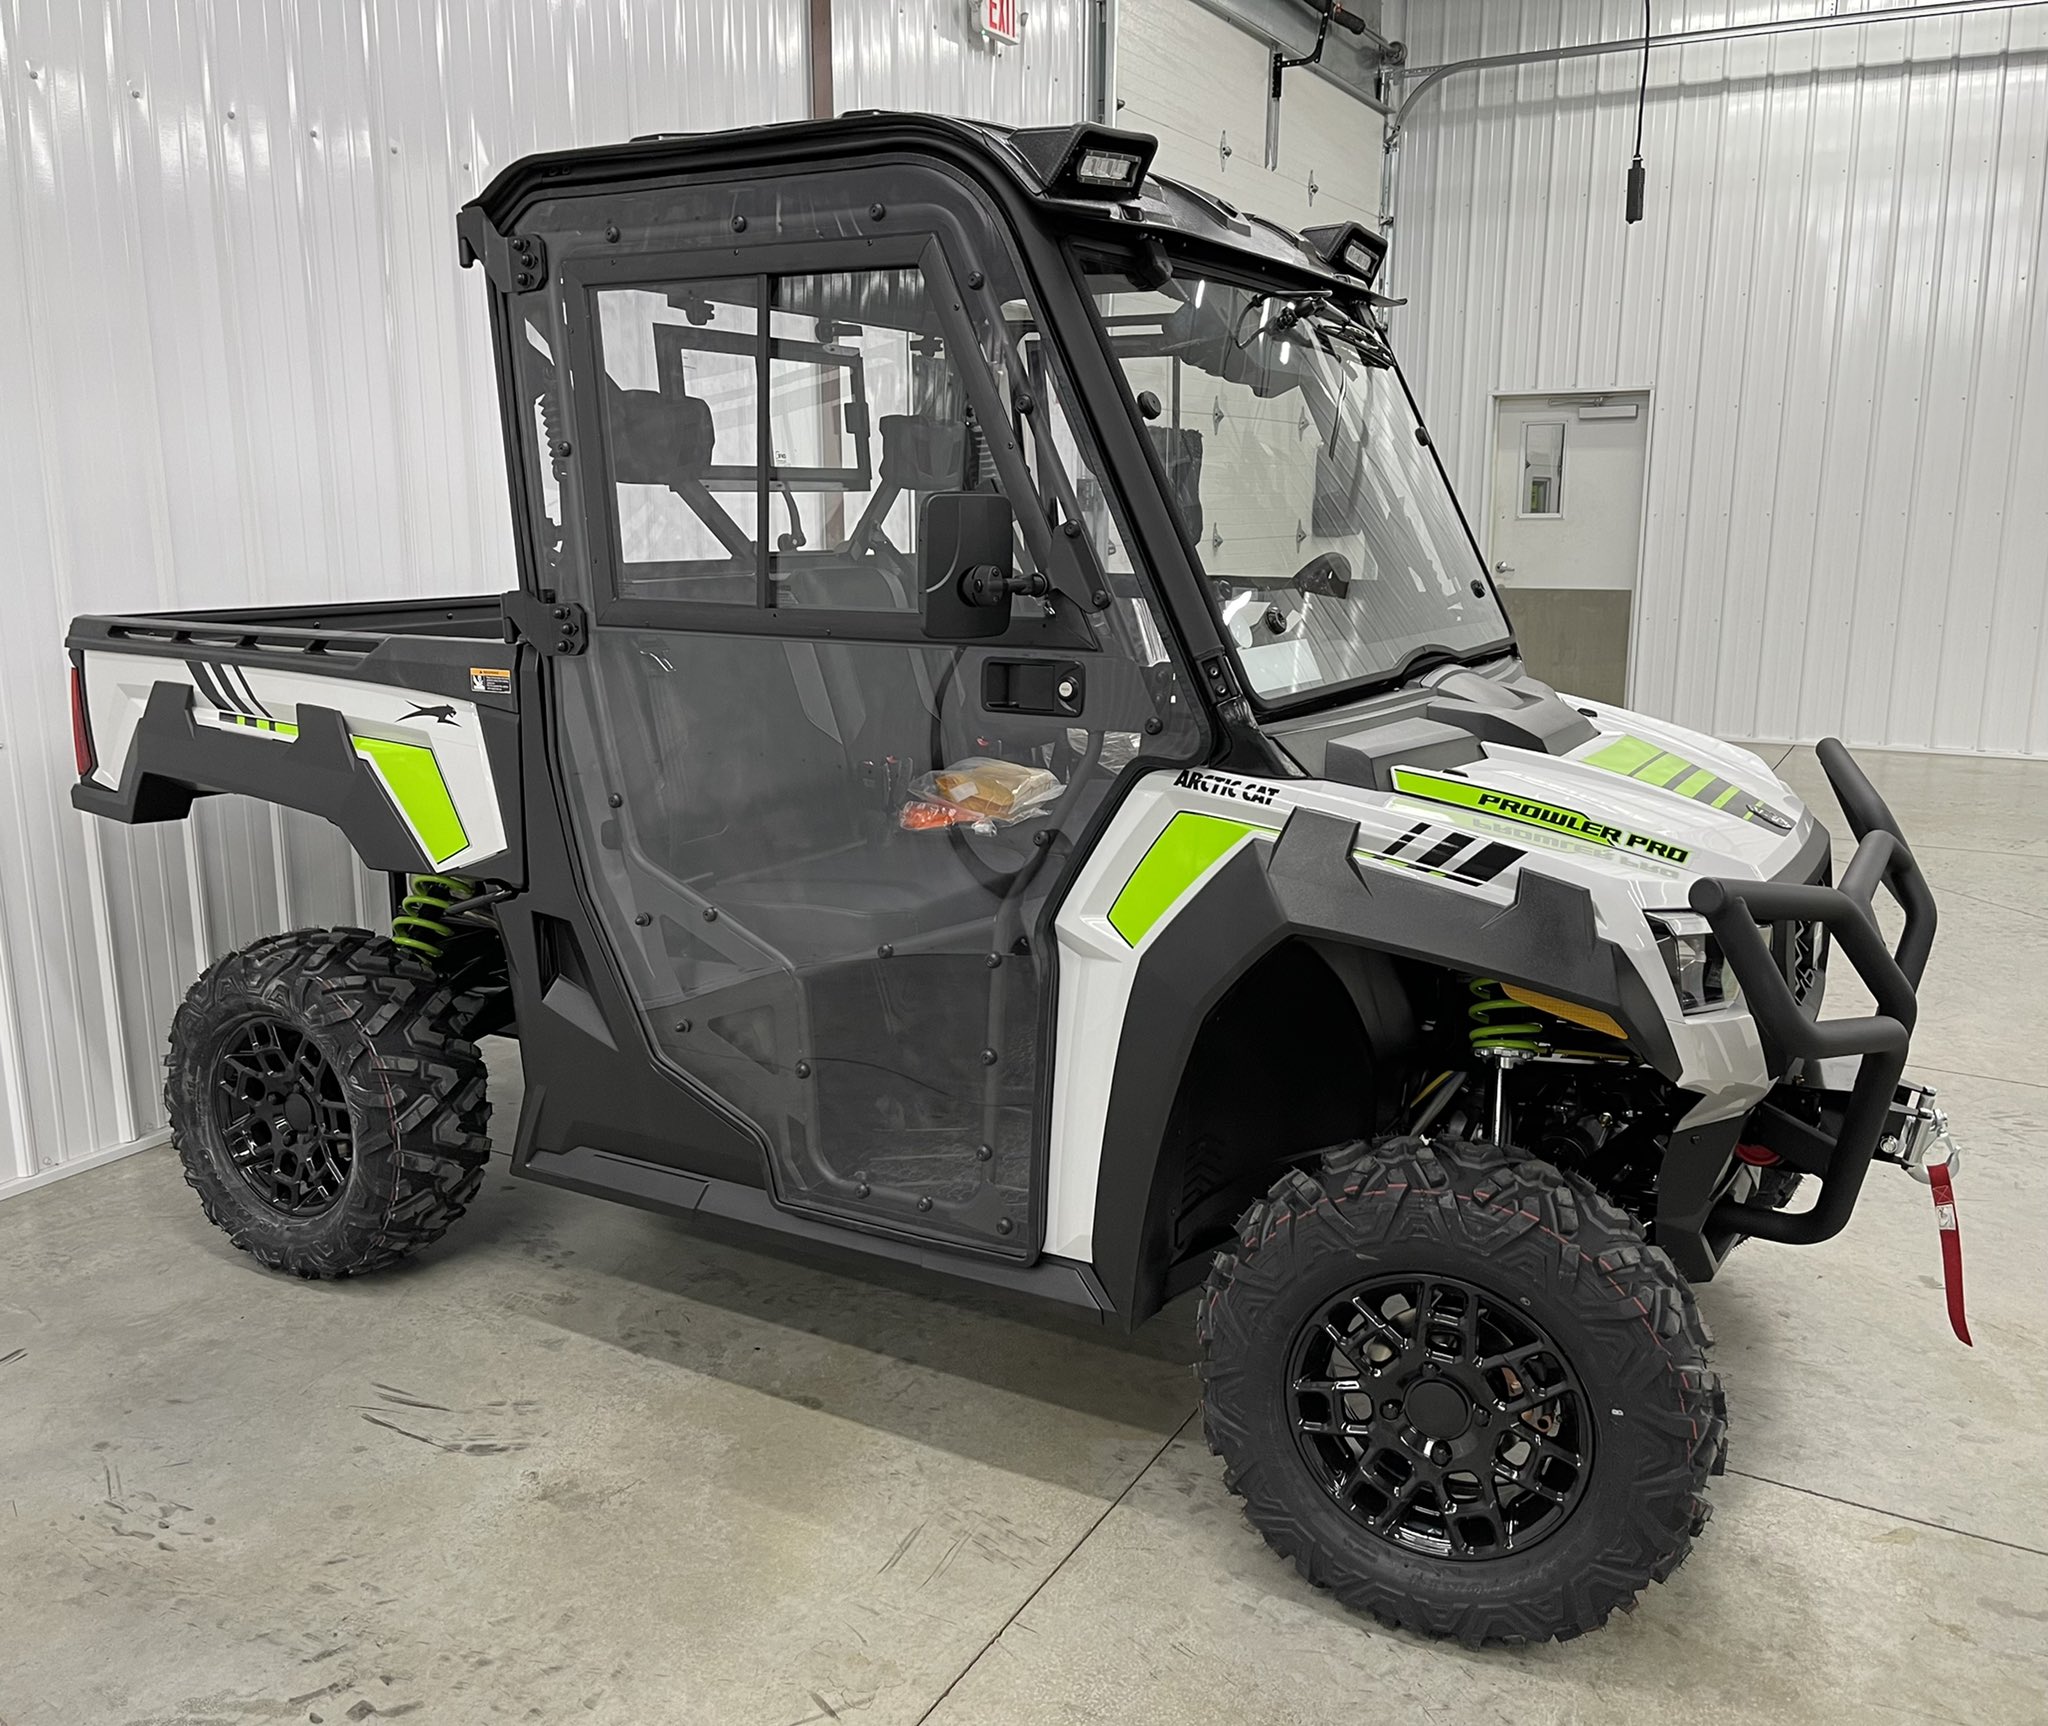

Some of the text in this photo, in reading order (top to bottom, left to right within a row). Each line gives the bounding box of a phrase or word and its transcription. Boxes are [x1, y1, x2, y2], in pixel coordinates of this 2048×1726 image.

[1173, 769, 1280, 806] ARCTIC CAT
[1477, 793, 1690, 864] PROWLER PRO
